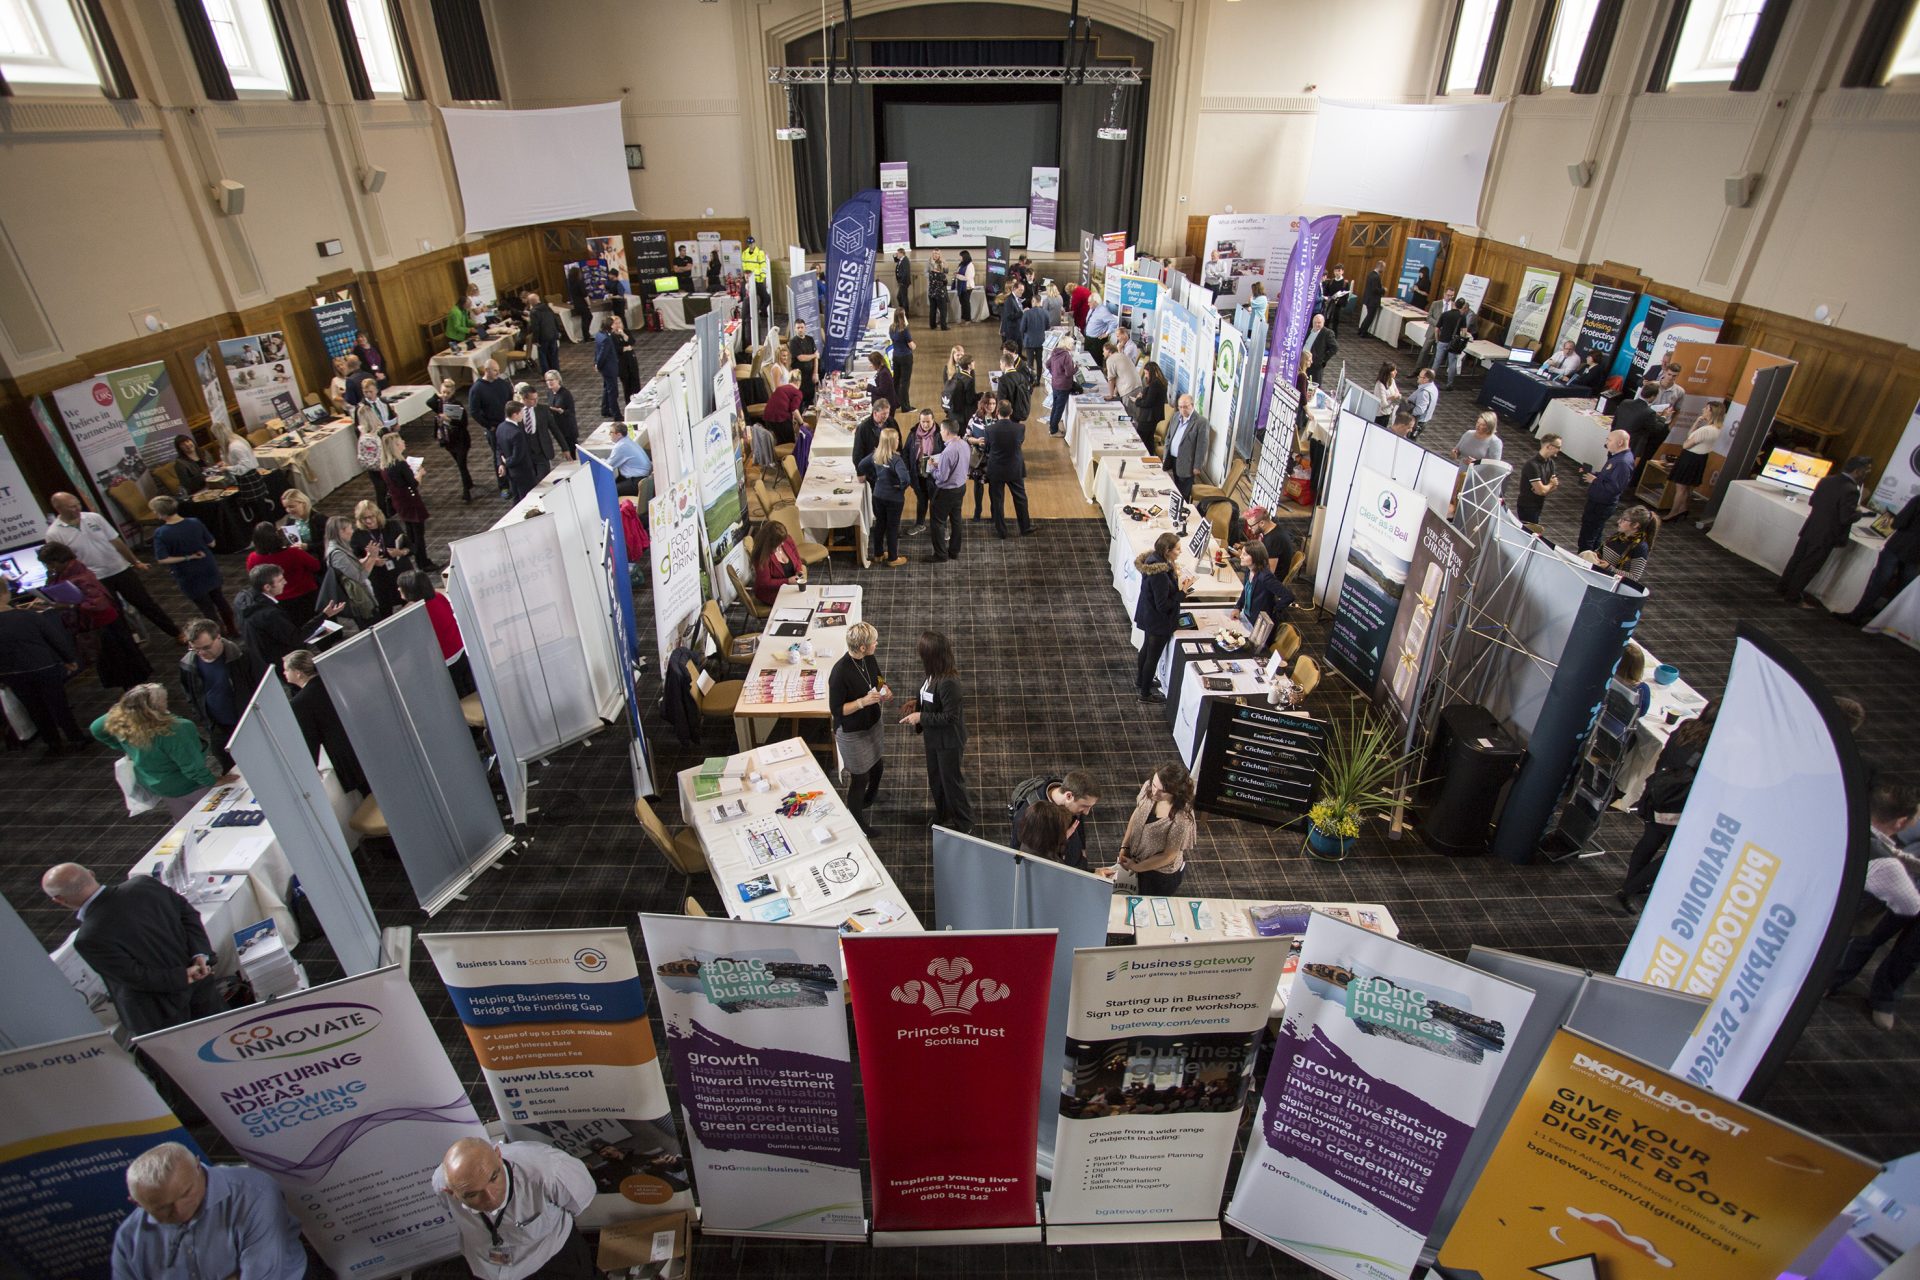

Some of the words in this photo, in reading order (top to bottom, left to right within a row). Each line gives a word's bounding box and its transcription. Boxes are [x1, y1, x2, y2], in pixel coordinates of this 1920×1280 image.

[1307, 264, 1322, 302] MAGAZINE
[829, 260, 857, 339] GENESIS
[319, 316, 344, 327] Scotland
[1584, 320, 1612, 332] Advising
[1587, 311, 1621, 325] Supporting
[1582, 328, 1616, 343] Protecting
[1592, 340, 1613, 352] YOU
[95, 391, 113, 402] UWS
[120, 381, 158, 399] UWS
[64, 409, 79, 418] We
[69, 415, 100, 430] believe
[100, 411, 110, 420] in
[76, 421, 125, 442] Partnership
[2, 514, 23, 523] Your
[1359, 506, 1378, 522] Clear
[1378, 520, 1389, 530] as
[1393, 527, 1408, 543] Bell
[671, 524, 695, 547] FOOD
[672, 541, 690, 560] AND
[1426, 526, 1438, 541] VERY
[1437, 538, 1463, 569] CRICTON
[672, 551, 697, 576] DRINK
[1250, 712, 1278, 723] Crichton
[1245, 745, 1272, 756] Crichton
[1241, 761, 1268, 772] Crichton
[1238, 776, 1265, 787] Crichton
[1235, 791, 1261, 801] Crichton
[456, 961, 497, 969] Business
[528, 957, 570, 966] Scotland
[704, 957, 766, 974] #DnG
[1132, 959, 1191, 970] business
[1193, 956, 1255, 967] gateway
[706, 971, 775, 985] means
[710, 981, 801, 999] business
[1355, 975, 1427, 1006] #DnG
[469, 994, 514, 1005] Helping
[517, 993, 577, 1002] Businesses
[1106, 997, 1150, 1008] Starting
[1154, 996, 1169, 1004] up
[1187, 992, 1241, 1002] Business?
[1355, 989, 1433, 1019] means
[473, 1006, 509, 1016] Bridge
[513, 1004, 531, 1012] the
[534, 1002, 579, 1012] Funding
[580, 1002, 603, 1012] Gap
[1086, 1010, 1111, 1019] Sign
[1114, 1009, 1130, 1017] up
[1133, 1006, 1144, 1014] to
[1148, 1005, 1167, 1013] our
[1171, 1004, 1193, 1012] free
[1196, 1002, 1259, 1011] workshops.
[1111, 1017, 1230, 1031] bgateway.com/events
[1353, 1001, 1457, 1041] business
[229, 1025, 274, 1046] CO
[235, 1012, 366, 1060] INNOVATE
[897, 1024, 960, 1040] Prince's
[963, 1024, 1005, 1037] Trust
[924, 1037, 979, 1047] Scotland
[688, 1052, 760, 1066] growth
[221, 1052, 362, 1104] NURTURING
[499, 1070, 594, 1084] www.bls.scot
[691, 1072, 744, 1086] inward
[747, 1077, 835, 1090] investment
[779, 1069, 834, 1081] start-up
[1292, 1054, 1371, 1094] growth
[525, 1086, 569, 1094] BLScotland
[693, 1084, 836, 1099] internationalisation
[1572, 1052, 1750, 1138] DIGITALBOOST
[230, 1083, 305, 1116] IDEAS
[240, 1080, 368, 1127] GROWING
[695, 1093, 724, 1103] digital
[726, 1096, 762, 1104] trading
[1289, 1066, 1384, 1110] sustainability
[1385, 1106, 1448, 1140] start-up
[248, 1096, 358, 1138] SUCCESS
[533, 1108, 567, 1116] Business
[697, 1102, 774, 1113] employment
[789, 1105, 838, 1117] training
[1285, 1073, 1344, 1105] inward
[1346, 1100, 1444, 1150] investment
[700, 1121, 746, 1131] green
[750, 1122, 839, 1135] credentials
[1283, 1085, 1440, 1159] internationalisation
[1556, 1086, 1621, 1126] GIVE
[1631, 1117, 1711, 1166] YOUR
[1100, 1135, 1135, 1143] subjects
[1279, 1102, 1362, 1143] employment
[1365, 1138, 1375, 1148] &
[1378, 1144, 1433, 1177] training
[1547, 1099, 1684, 1179] BUSINESS
[1687, 1167, 1711, 1186] A
[30, 1149, 129, 1178] confidential,
[1273, 1120, 1322, 1146] green
[1326, 1144, 1424, 1195] credentials
[1540, 1112, 1645, 1170] DIGITAL
[1653, 1166, 1760, 1226] BOOST
[890, 1174, 944, 1186] Inspiring
[948, 1175, 985, 1183] young
[1262, 1161, 1368, 1215] #DnGmeansbusiness
[901, 1183, 1008, 1196] princes-trust.org.uk
[920, 1193, 944, 1201] 0800
[948, 1192, 967, 1200] 842
[1525, 1141, 1739, 1256] bgateway.com/digitalboost
[1096, 1207, 1174, 1216] bgateway.com
